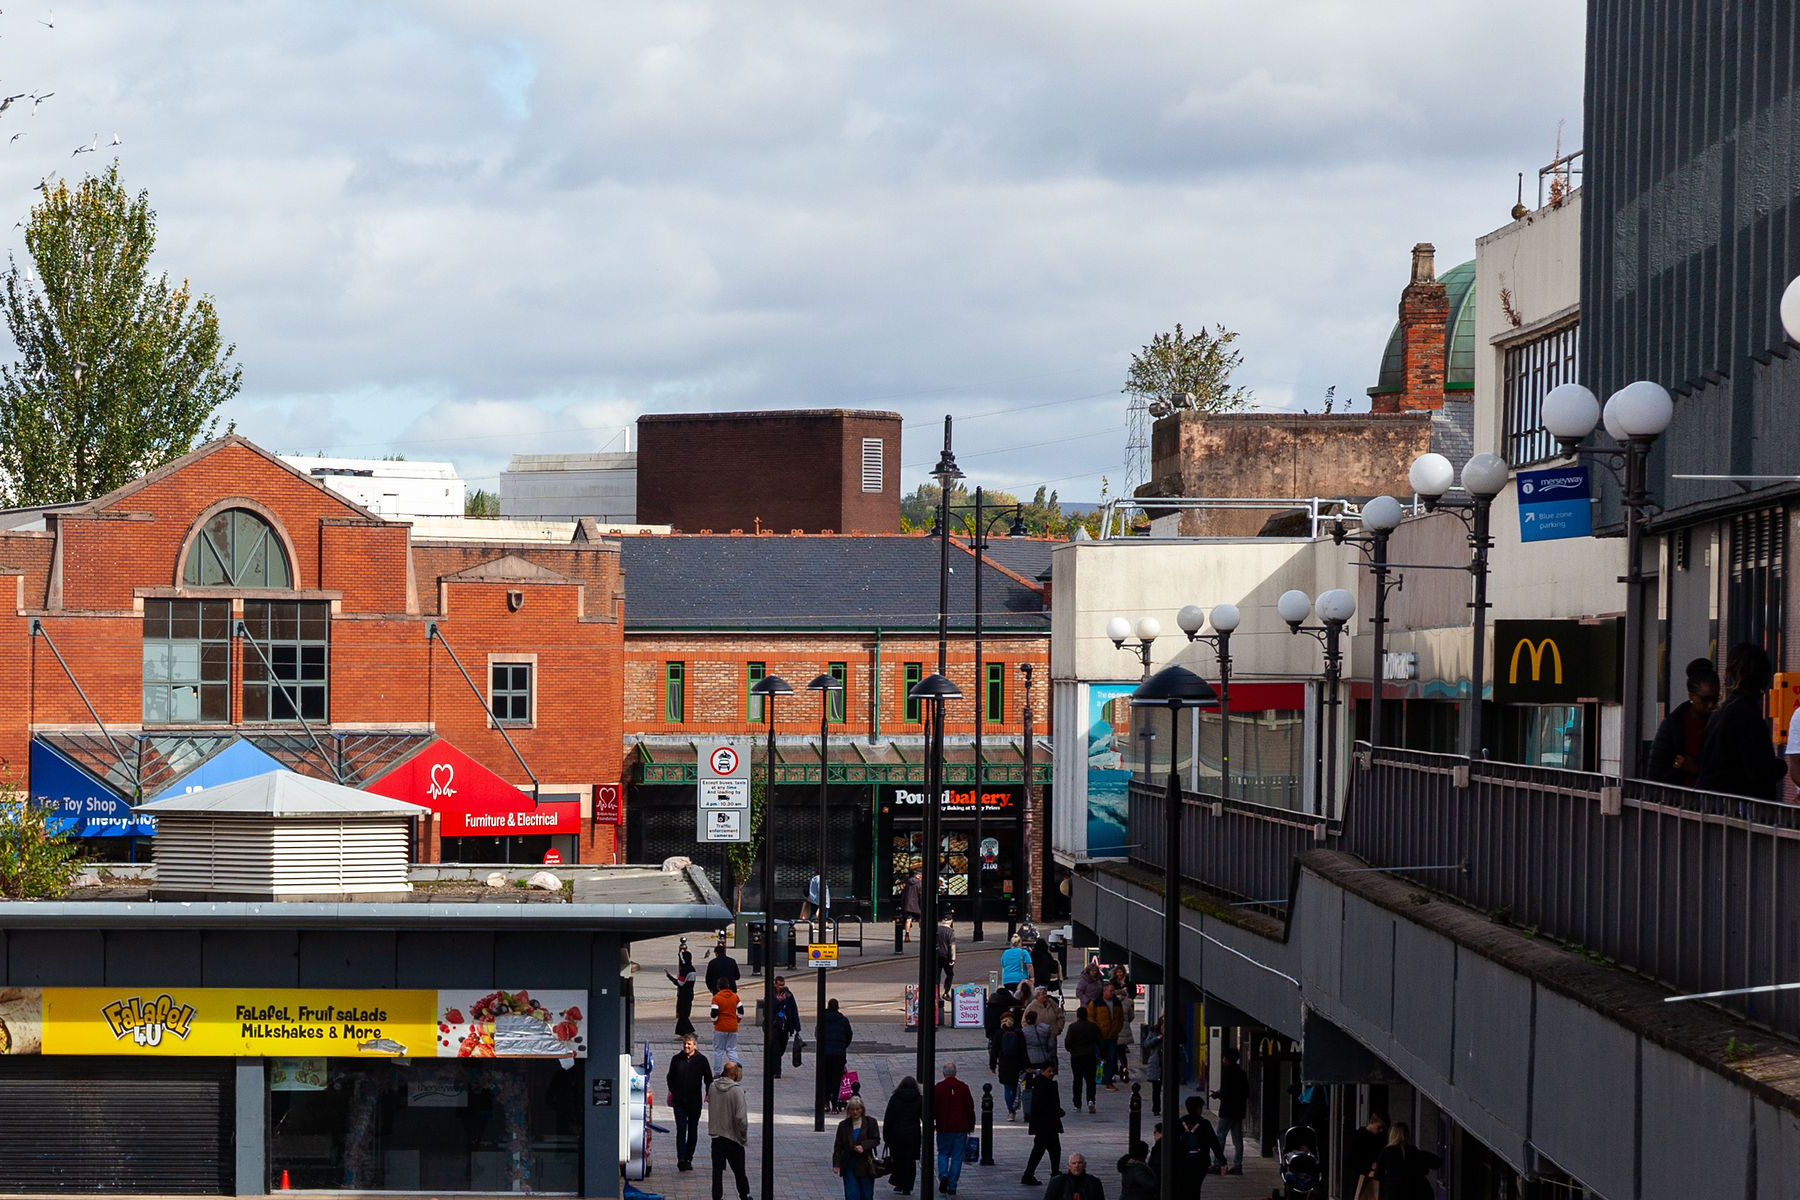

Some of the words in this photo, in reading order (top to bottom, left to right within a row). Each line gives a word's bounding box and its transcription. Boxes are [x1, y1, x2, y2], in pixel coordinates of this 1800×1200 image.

[1540, 476, 1584, 487] merseyway
[1539, 512, 1555, 520] Blue
[1540, 521, 1566, 531] parking
[63, 797, 83, 815] Toy
[86, 797, 117, 815] Shop
[465, 813, 505, 828] Furniture
[507, 812, 515, 827] &
[517, 812, 558, 827] Electrical
[298, 1005, 335, 1022] Fruit
[336, 1005, 387, 1022] salads
[133, 1023, 163, 1047] 4U
[241, 1023, 324, 1039] Milkshakes
[329, 1026, 338, 1039] &
[343, 1023, 382, 1039] More
